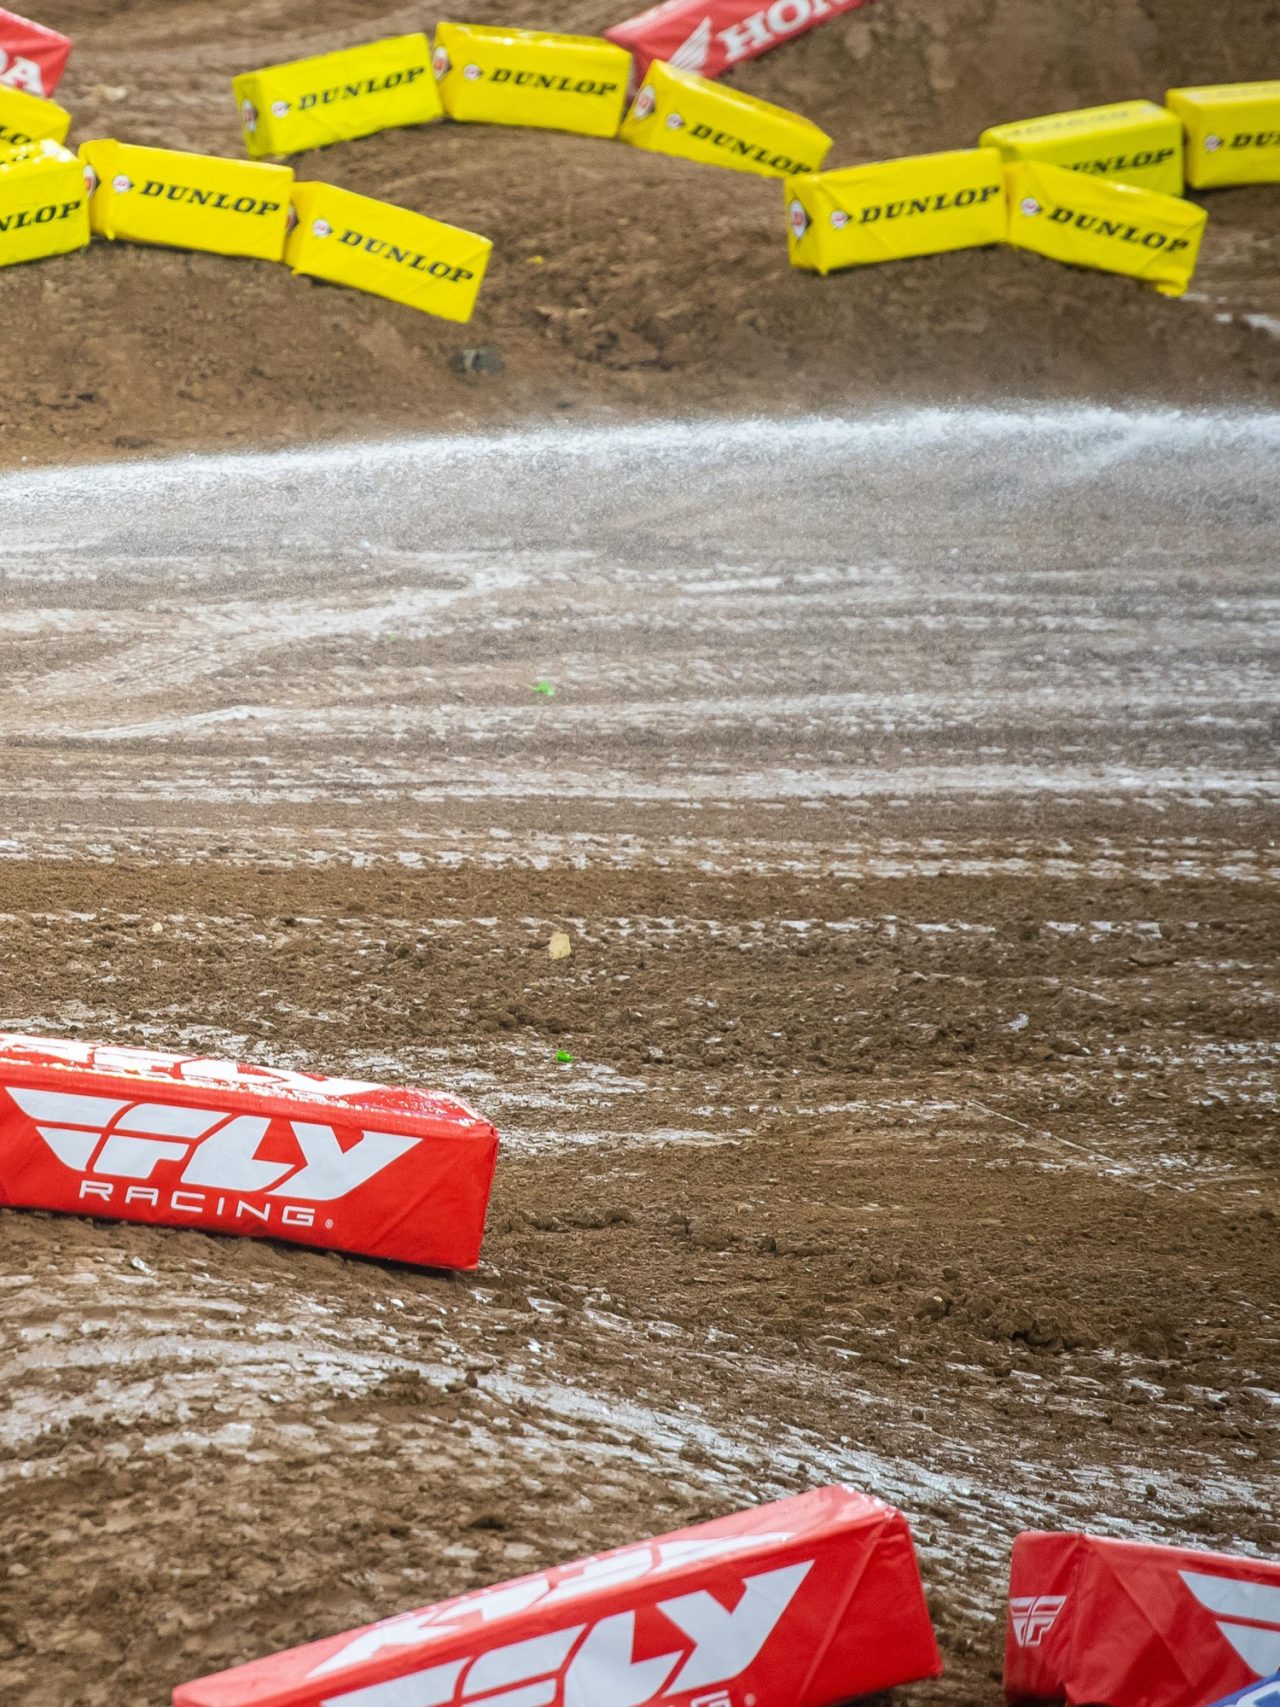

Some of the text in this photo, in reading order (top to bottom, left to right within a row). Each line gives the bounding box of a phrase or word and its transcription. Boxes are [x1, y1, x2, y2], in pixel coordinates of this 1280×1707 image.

[299, 67, 425, 110] DUNLOP
[490, 69, 617, 96] DUNLOP
[689, 124, 812, 175] DUNLOP
[140, 181, 280, 216] DUNLOP
[859, 185, 1001, 224] DUNLOP
[1048, 204, 1189, 252] DUNLOP
[337, 229, 473, 284] DUNLOP
[4, 1086, 423, 1201] FLY
[79, 1179, 316, 1228] RACING
